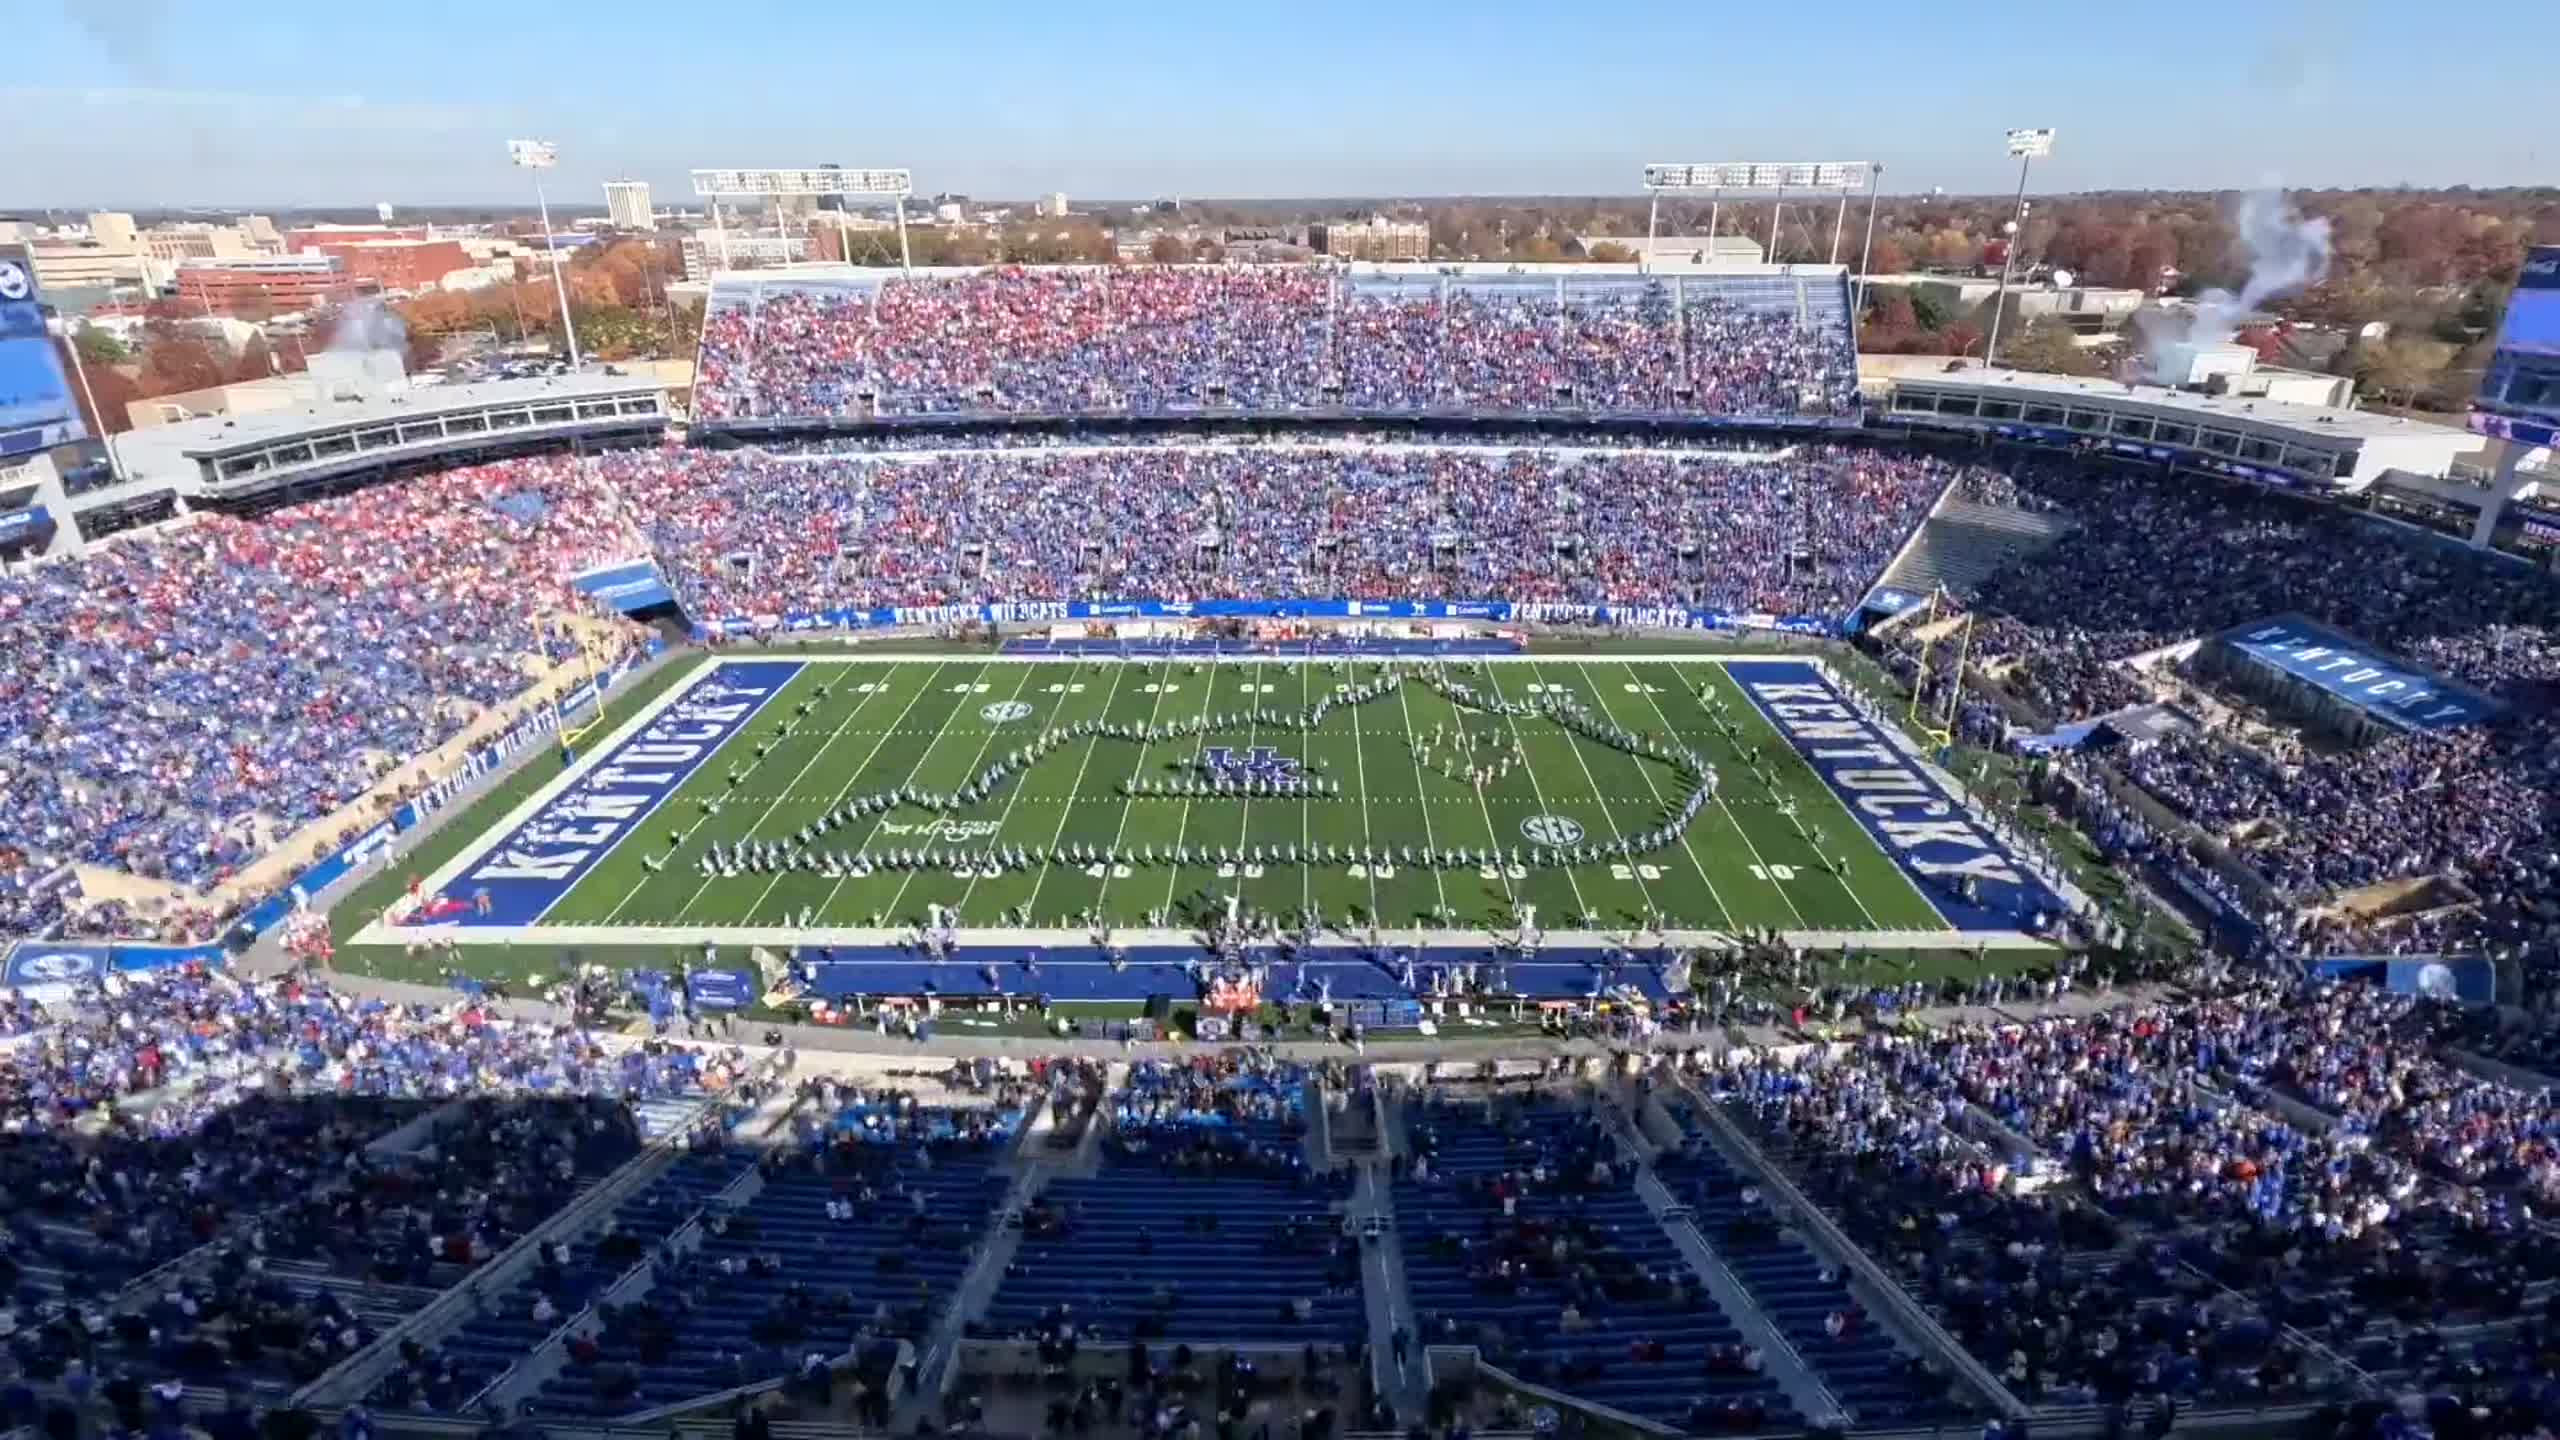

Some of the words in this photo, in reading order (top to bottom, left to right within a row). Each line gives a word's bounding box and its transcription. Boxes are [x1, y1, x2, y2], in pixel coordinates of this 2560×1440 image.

[894, 605, 981, 624] KENTUCKY
[989, 602, 1068, 623] WILDCATS
[1509, 602, 1597, 622] KENTUCKY
[2247, 626, 2466, 719] KENTUCKY
[409, 750, 489, 820] KENTUCKY
[494, 705, 557, 761] WILDCATS
[1203, 746, 1300, 785] UK
[471, 685, 769, 880] KENTUCKY
[1750, 682, 2024, 884] KENTUCKY
[1523, 817, 1582, 842] SEC
[1347, 863, 1396, 879] 40
[1611, 864, 1662, 879] 20
[1748, 864, 1795, 880] 10
